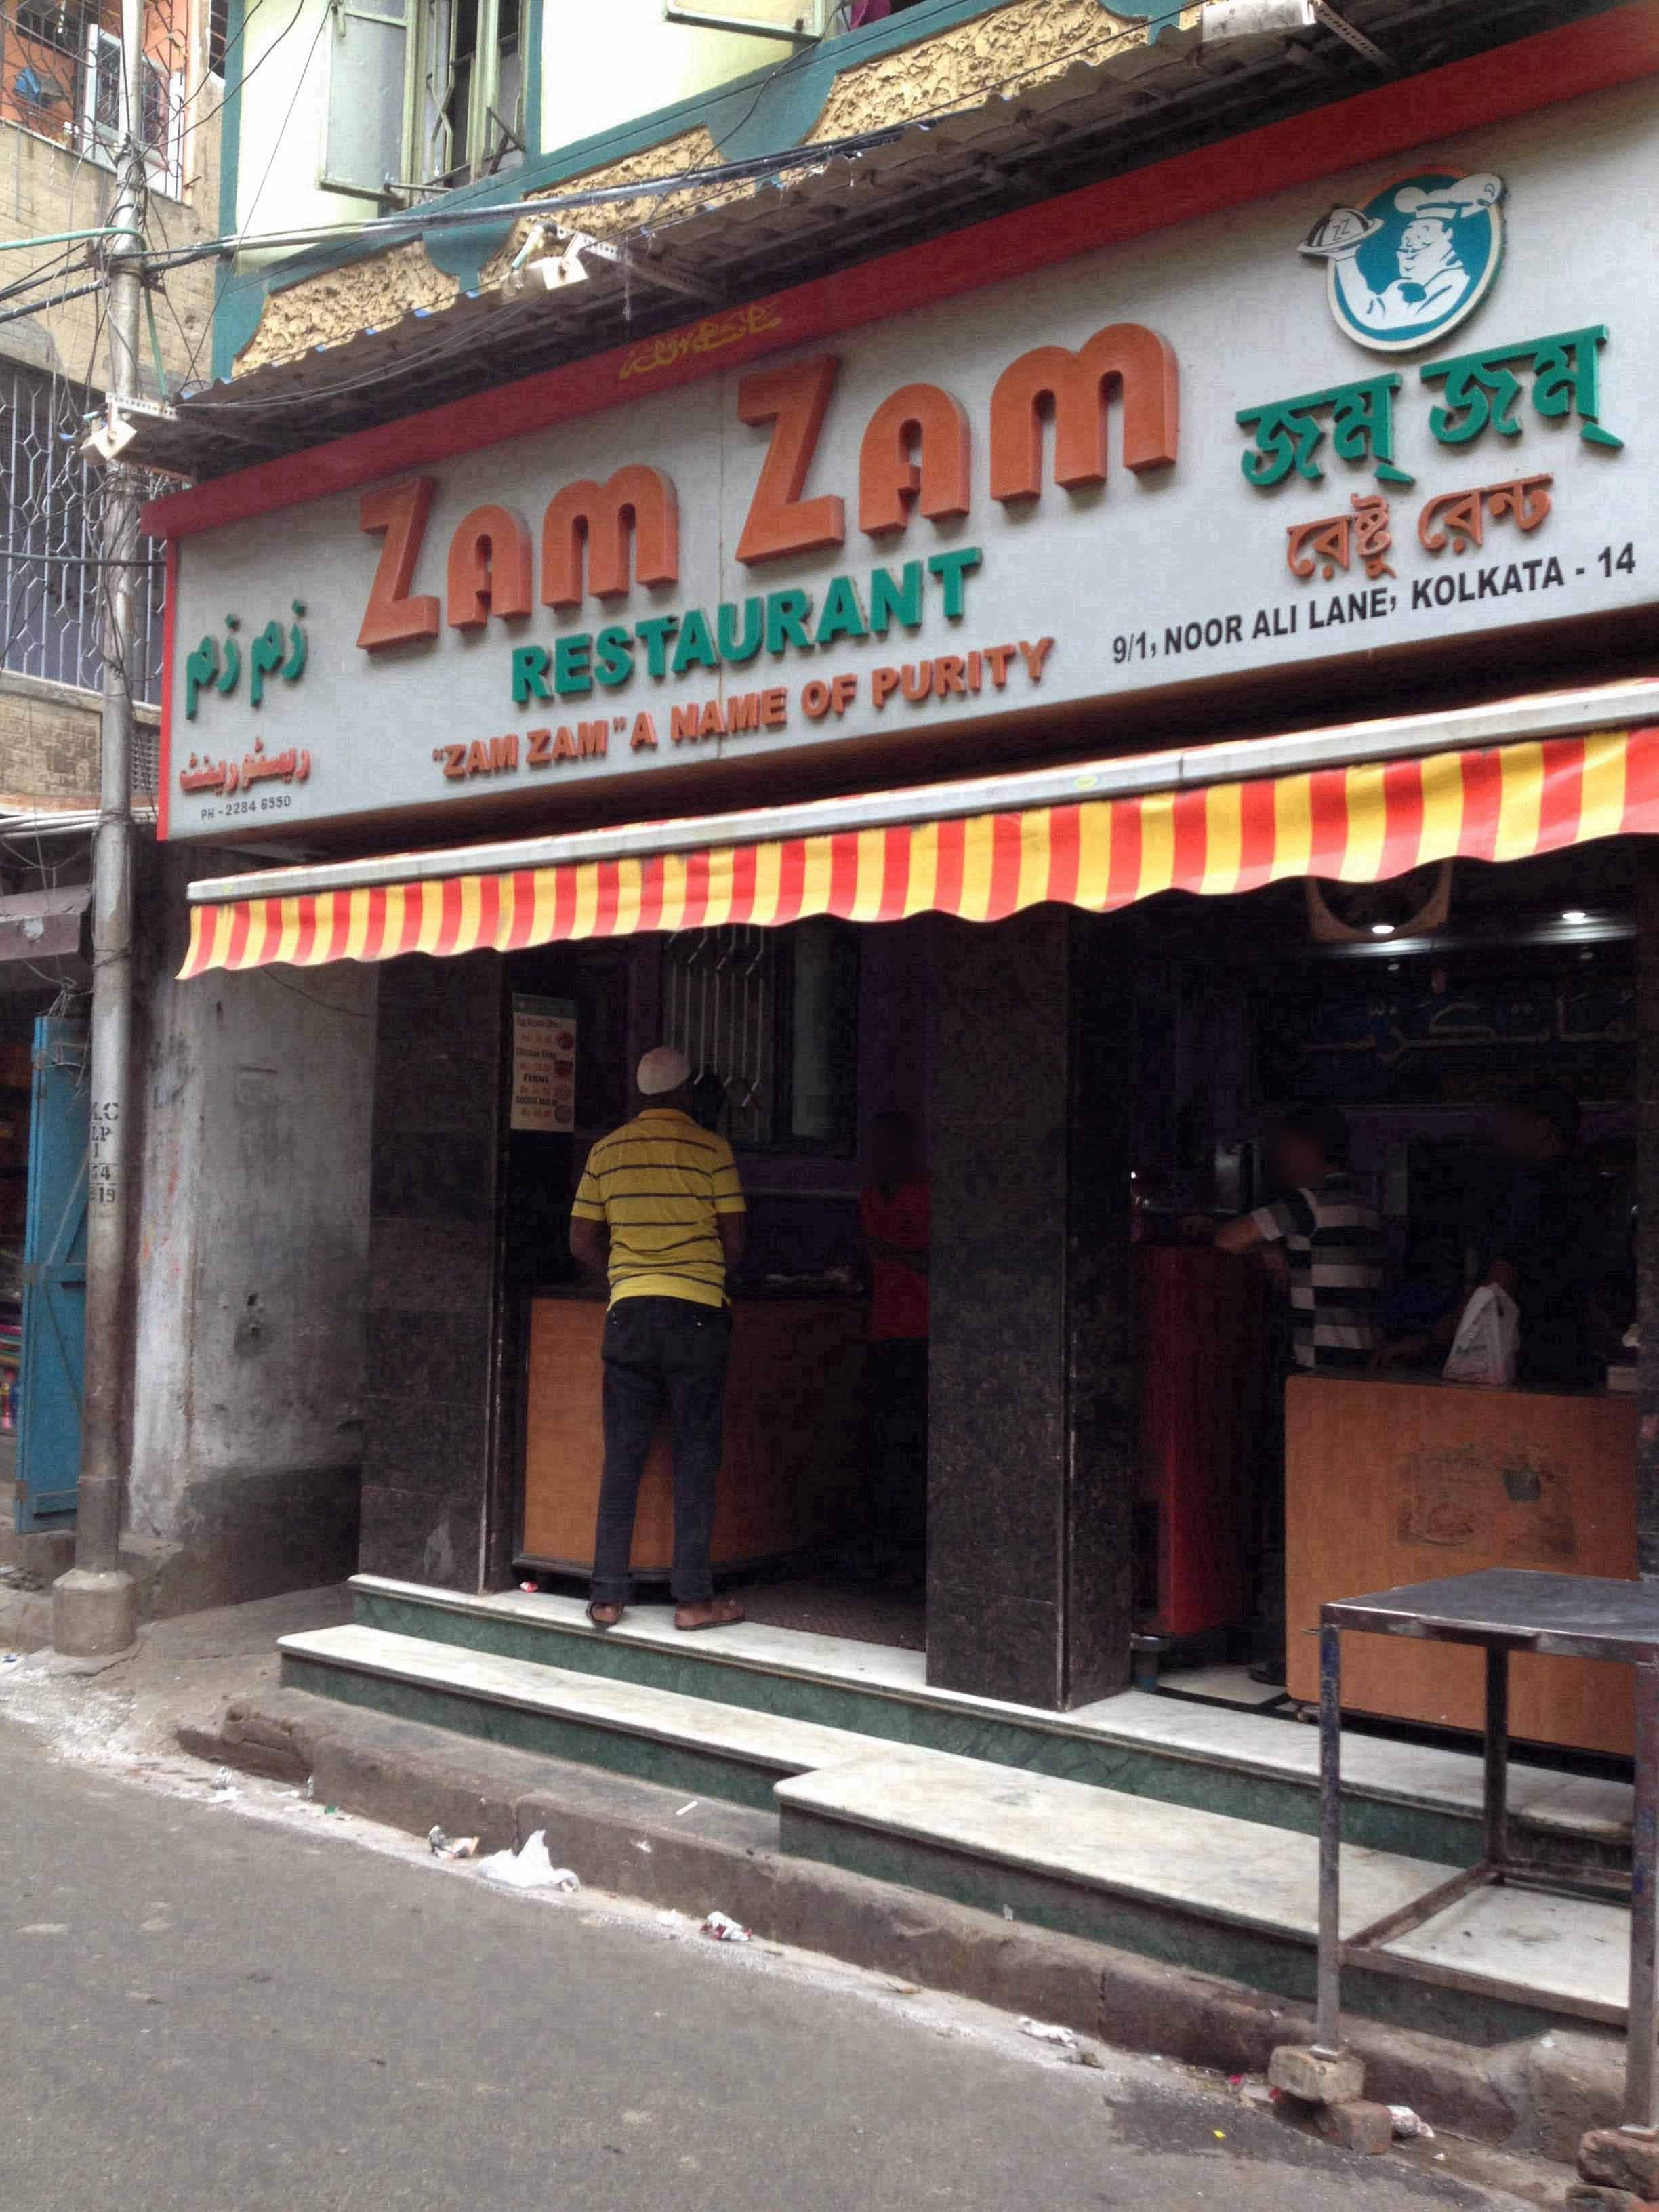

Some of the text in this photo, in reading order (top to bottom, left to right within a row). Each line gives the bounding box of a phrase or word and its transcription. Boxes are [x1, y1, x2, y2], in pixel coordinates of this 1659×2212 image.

[512, 547, 983, 703] RESTAURANT
[1164, 614, 1242, 655] NOOR
[1252, 604, 1296, 640] ALI
[1309, 586, 1397, 629] LANE,
[1411, 556, 1565, 610] KOLKATA
[1597, 542, 1637, 577] 14
[630, 712, 658, 750] A
[670, 686, 787, 743] NAME
[801, 673, 857, 718] OF
[871, 636, 1054, 708] PURITY
